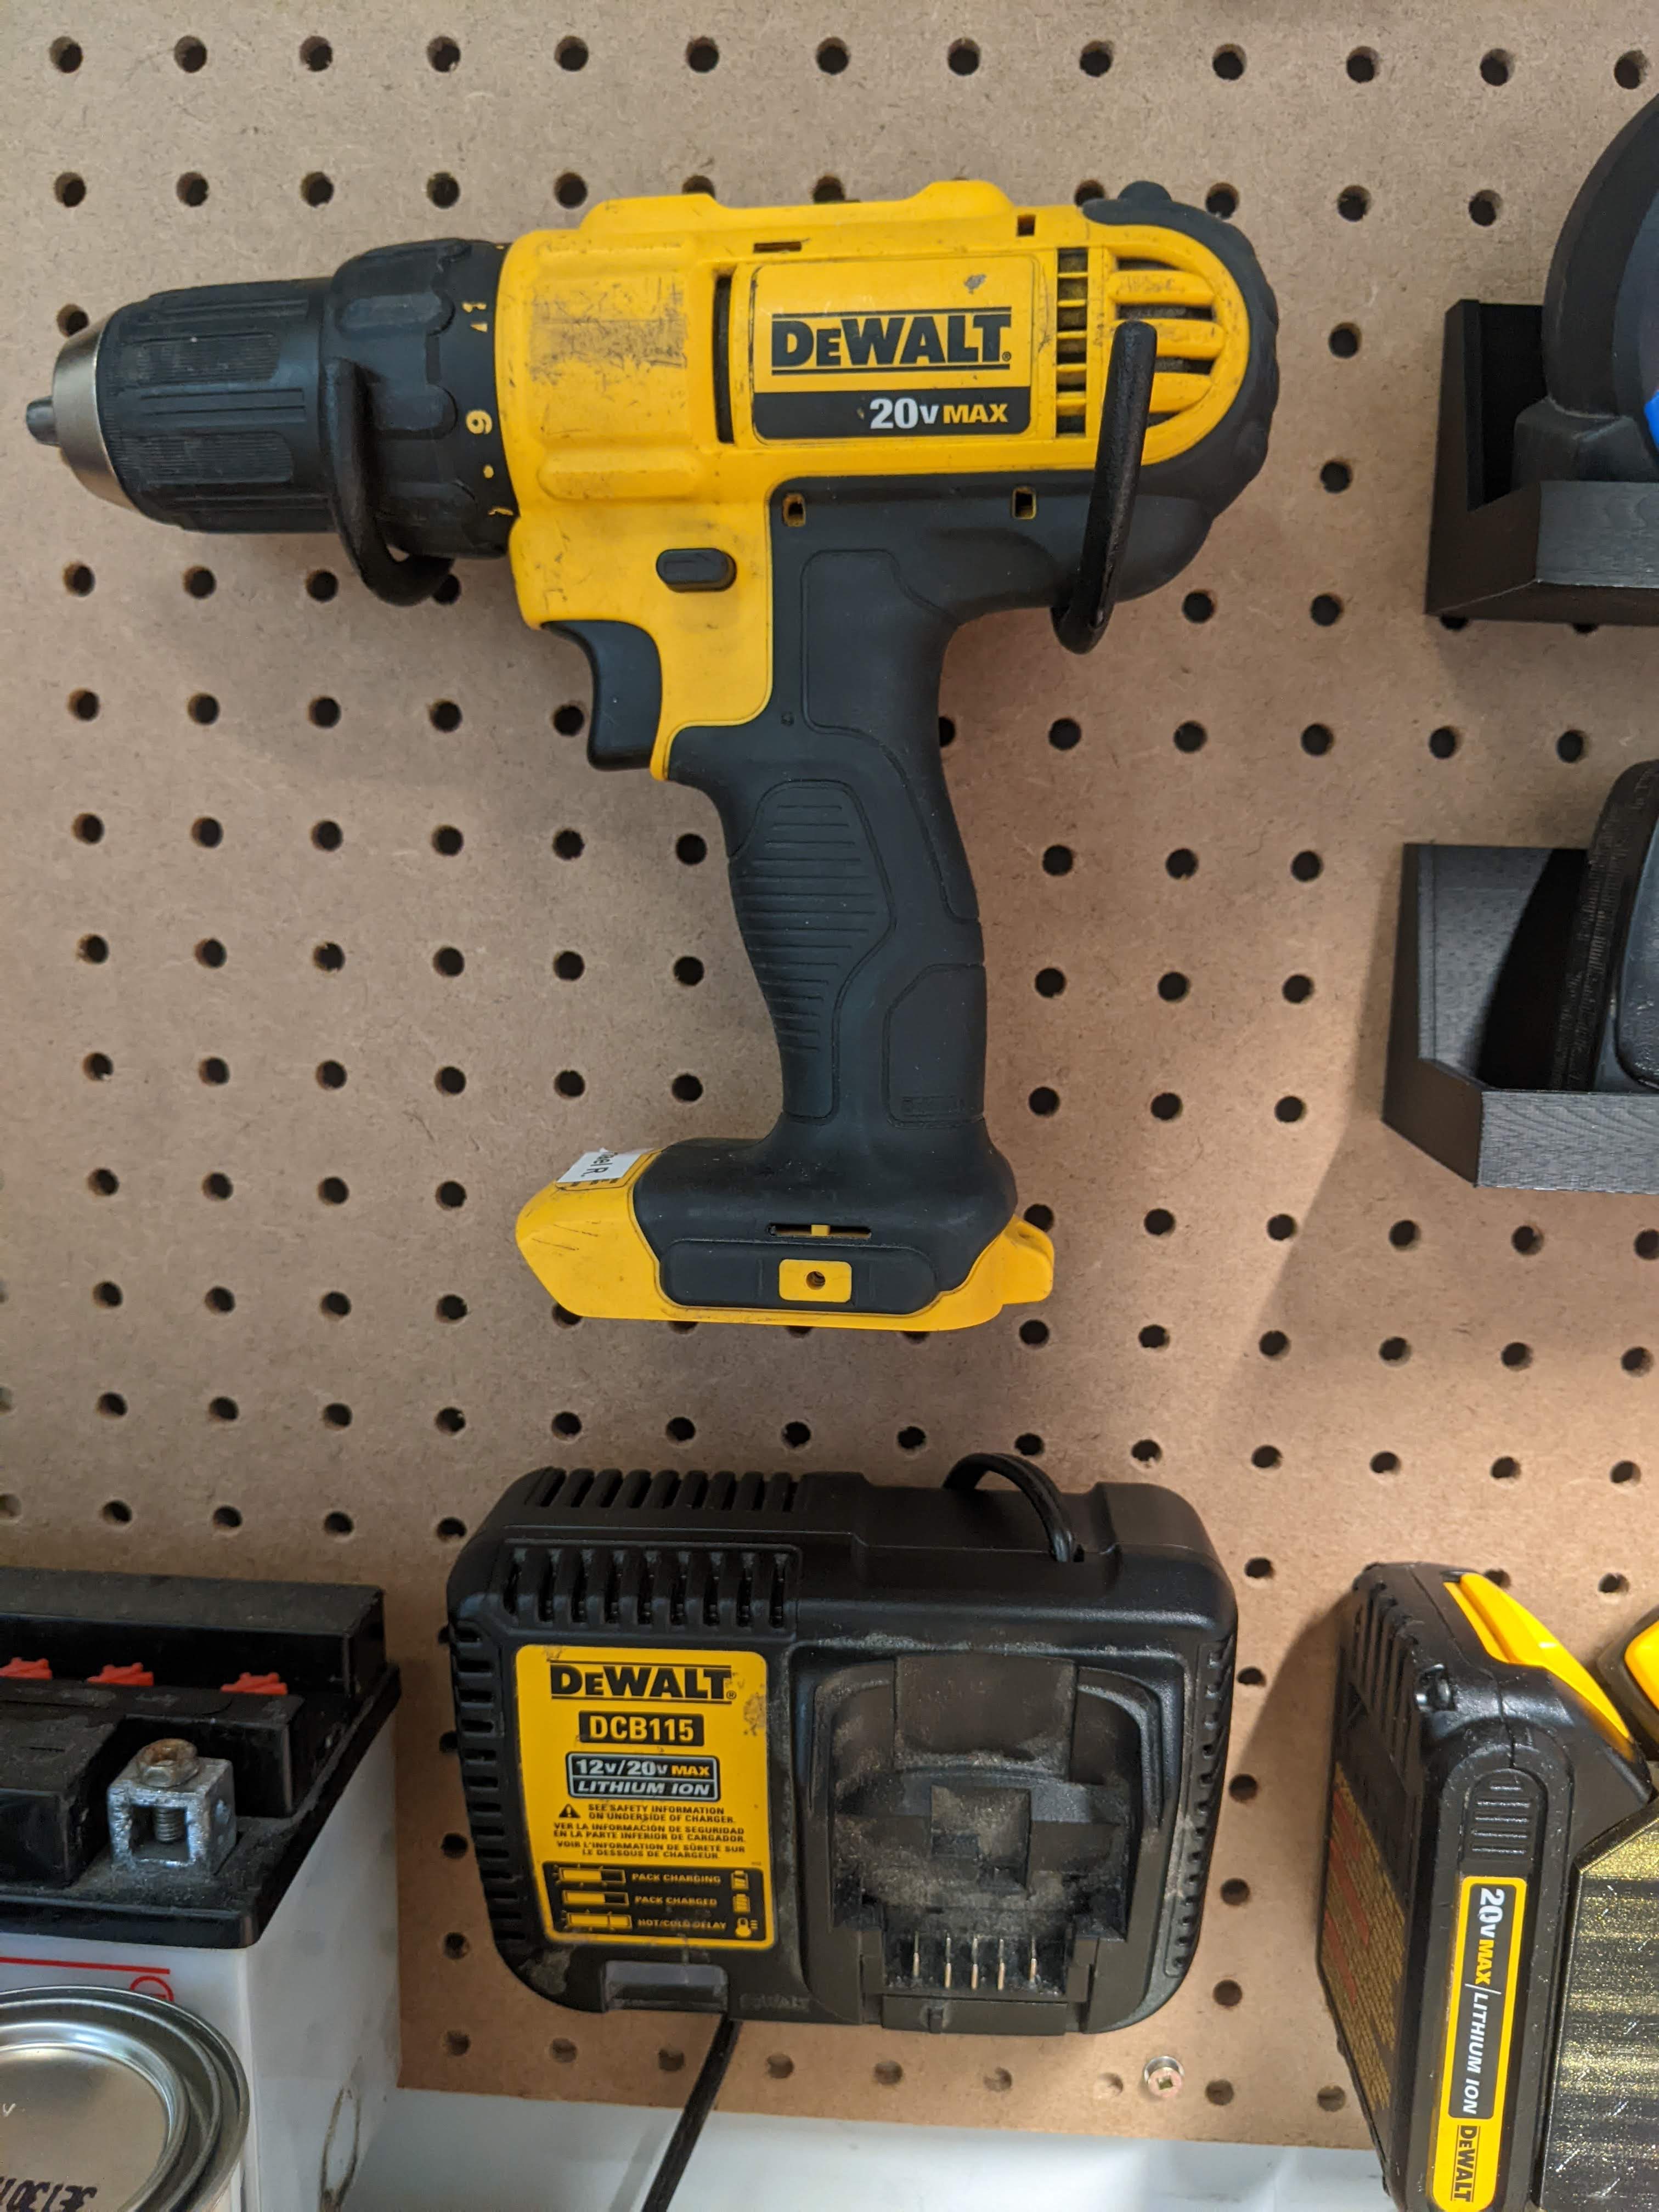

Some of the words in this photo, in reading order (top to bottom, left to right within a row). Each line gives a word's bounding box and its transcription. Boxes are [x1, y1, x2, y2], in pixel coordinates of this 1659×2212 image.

[943, 403, 1008, 424] MAX
[589, 1714, 695, 1742] DCB115
[670, 1766, 710, 1777] MAX
[577, 1780, 664, 1795] LITHIUM
[670, 1783, 710, 1796] ION
[588, 1803, 607, 1812] SEE
[610, 1804, 648, 1813] SAFETY
[651, 1805, 724, 1815] INFORMATION
[607, 1813, 666, 1821] UNDERSIDE
[586, 1831, 616, 1839] PARTE
[621, 1832, 668, 1840] INFERIOR
[685, 1826, 744, 1835] SEGURIDAD
[596, 1849, 644, 1857] DESSOUS
[725, 1845, 745, 1853] SUR
[631, 1872, 661, 1882] PACK
[663, 1874, 721, 1884] CHARGING
[634, 1895, 663, 1905] PACK
[665, 1897, 718, 1906] CHARGED
[637, 1918, 691, 1928] HOT/COLD
[692, 1921, 727, 1929] DELAY
[1474, 1938, 1496, 1985] MAX
[1466, 1993, 1489, 2074] LITHIUM
[1462, 2077, 1480, 2115] ION
